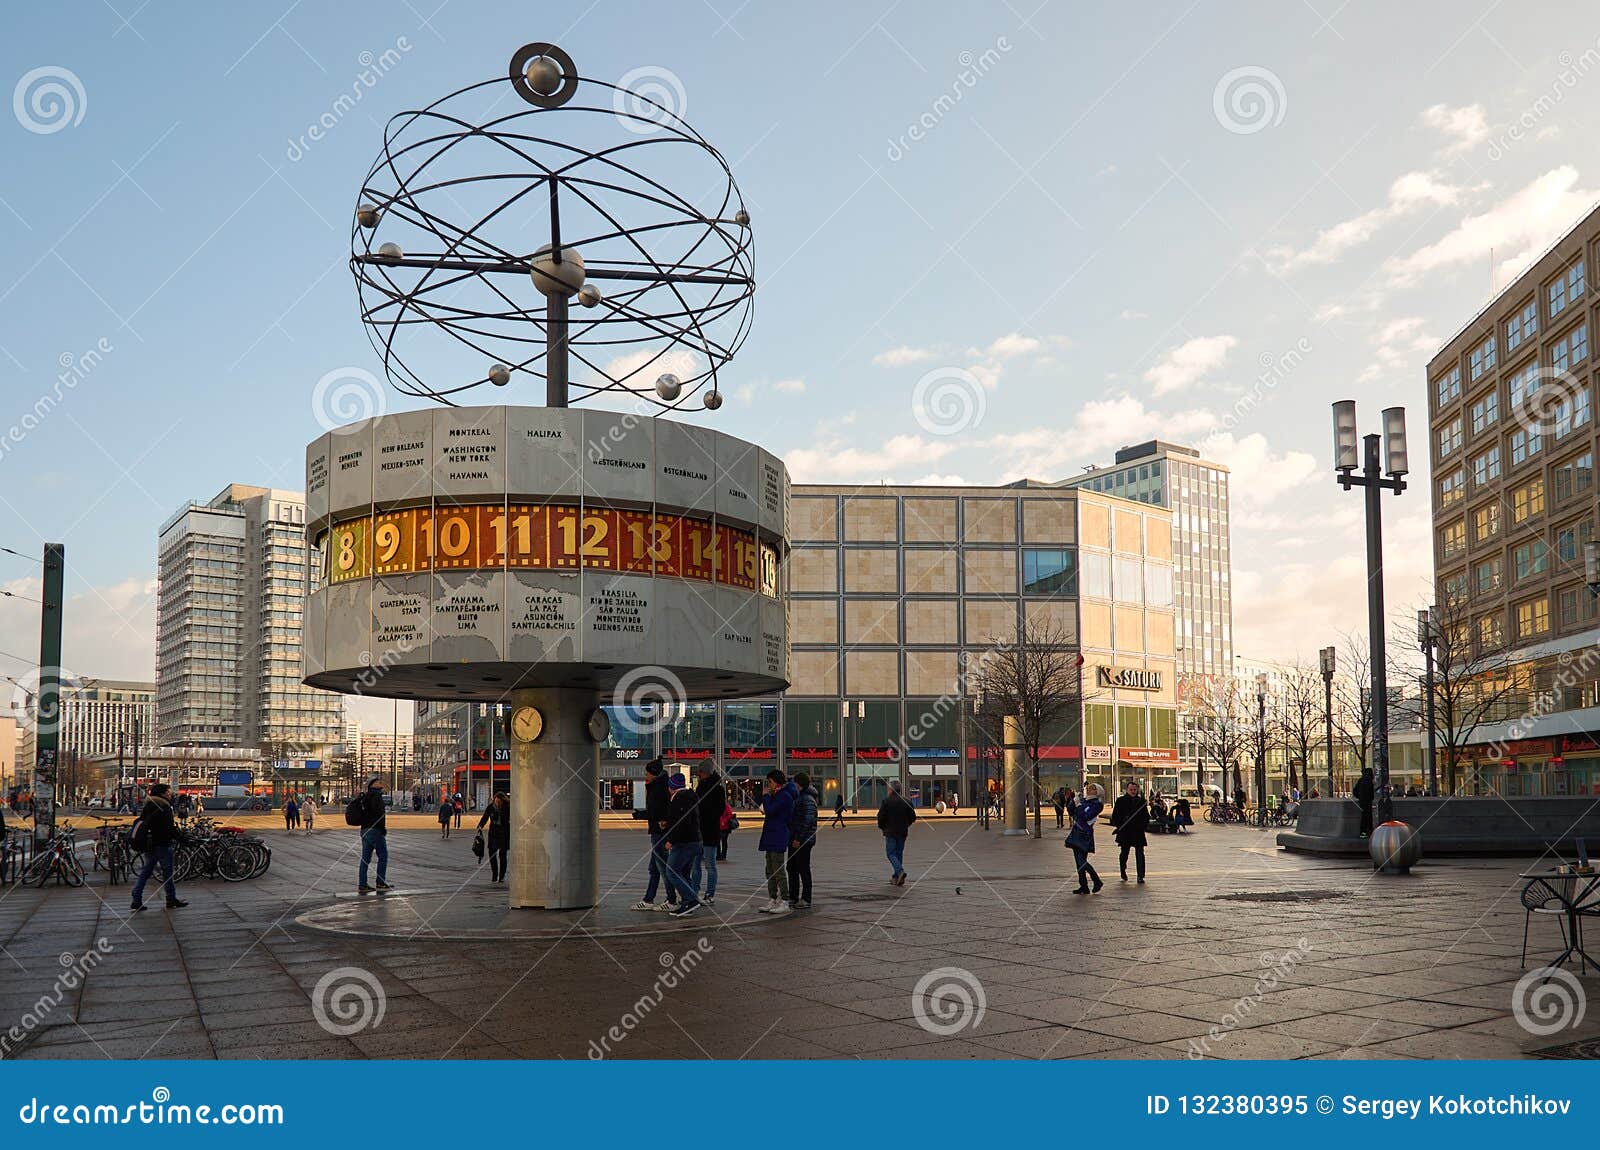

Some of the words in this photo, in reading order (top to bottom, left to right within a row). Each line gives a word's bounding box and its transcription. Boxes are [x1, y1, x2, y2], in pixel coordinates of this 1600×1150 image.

[449, 428, 491, 437] MONTREAL
[527, 429, 562, 438] HALIFAX
[381, 446, 395, 454] NEW
[397, 441, 424, 452] ORLEANS
[443, 445, 497, 454] WASHINGTON
[449, 455, 467, 463] NEW
[470, 454, 490, 462] YORK
[449, 471, 489, 480] HAVANNA
[421, 516, 471, 557] 10
[489, 515, 531, 555] 11
[557, 516, 609, 556] 12
[375, 523, 401, 563] 9
[627, 521, 672, 562] 13
[338, 531, 355, 571] 8
[688, 529, 722, 570] 14
[734, 540, 757, 580] 15
[451, 596, 485, 604] PANAMA
[525, 596, 563, 604] CARACAS
[590, 596, 602, 605] RIO
[604, 598, 613, 606] DE
[615, 598, 648, 608] JANEIRO
[401, 607, 422, 616] STADT
[529, 604, 540, 612] LA
[543, 604, 558, 612] PAZ
[616, 607, 639, 615] PAULO
[457, 613, 478, 621] QUITO
[523, 611, 564, 621] ASUNCIÓN
[596, 614, 641, 624] MONTEVIDEO
[383, 624, 417, 634] MANAGUA
[458, 622, 477, 630] LIMA
[593, 623, 621, 632] BUENOS
[622, 625, 644, 633] AIRES
[1121, 669, 1162, 688] SATURN
